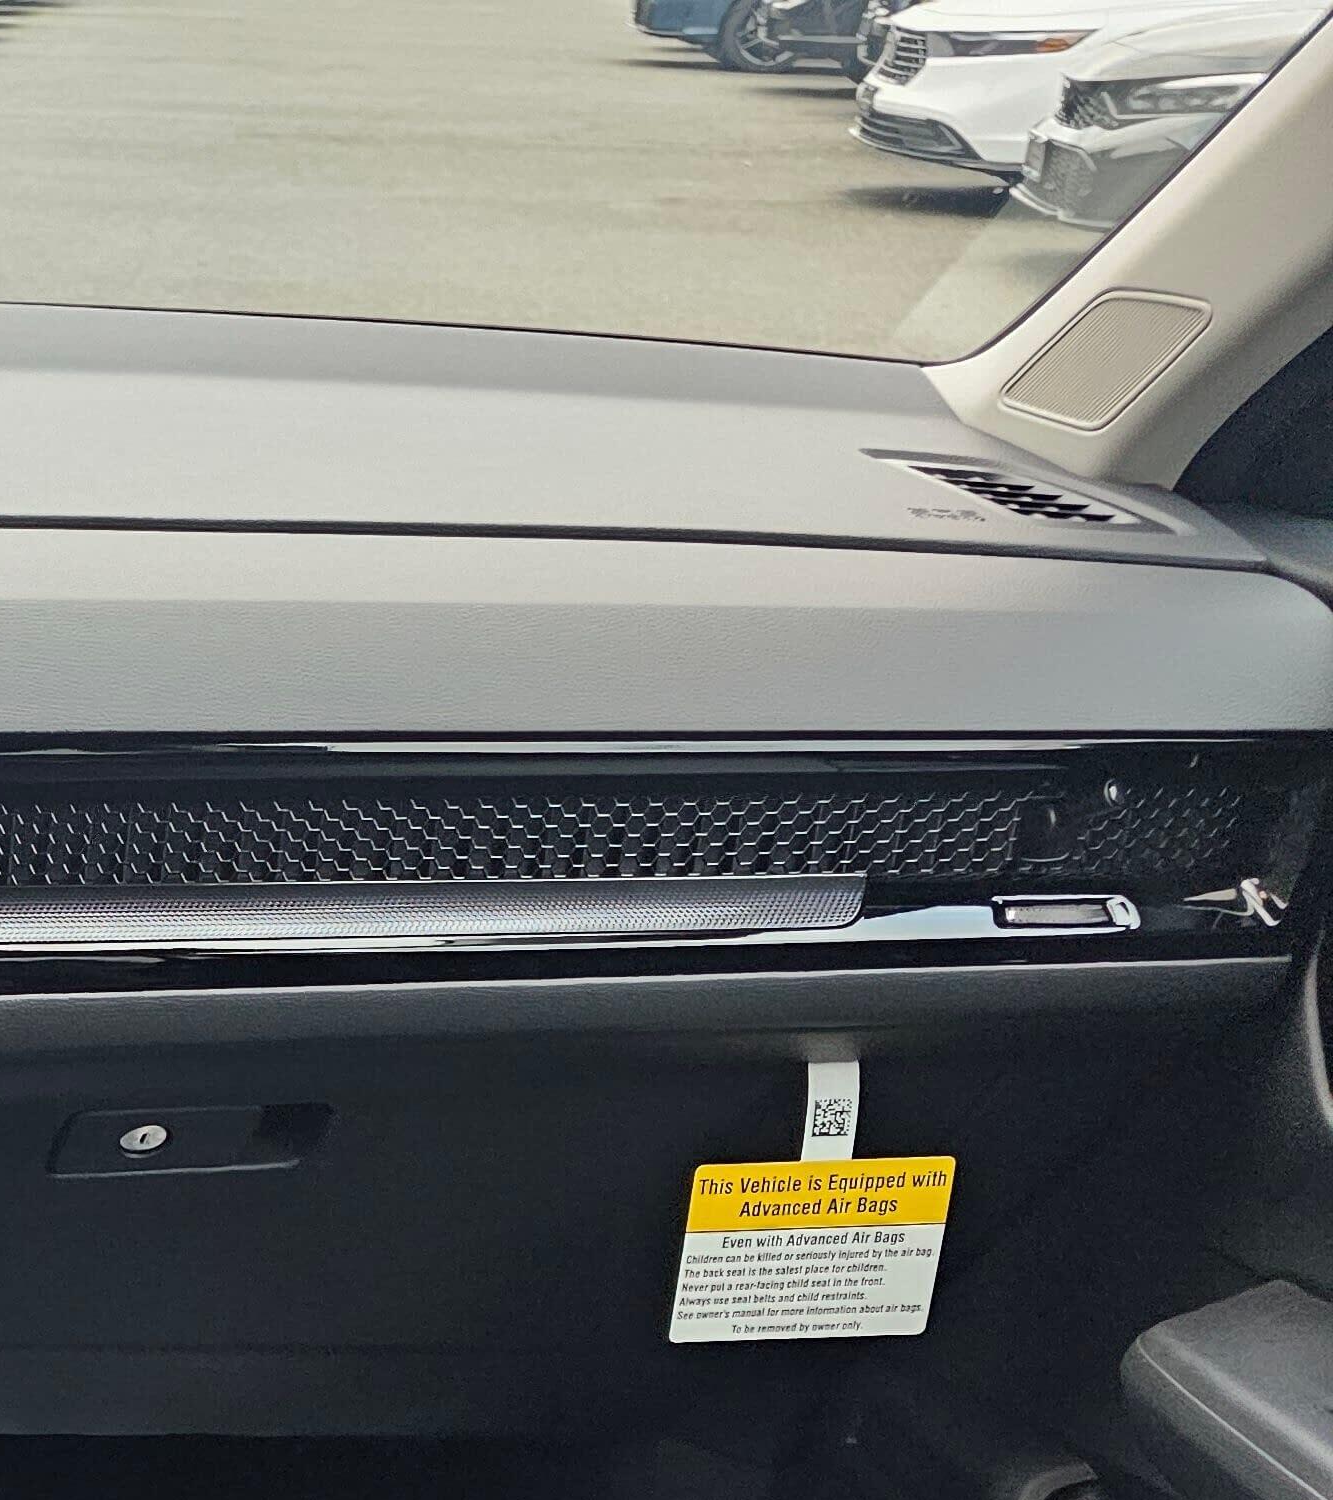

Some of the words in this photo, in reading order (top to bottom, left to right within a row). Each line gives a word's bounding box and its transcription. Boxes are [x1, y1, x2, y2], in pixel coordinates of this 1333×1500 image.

[699, 1178, 733, 1195] This
[740, 1176, 802, 1194] Vehicle
[807, 1176, 823, 1192] is
[828, 1172, 906, 1193] Equipped
[912, 1170, 948, 1188] with
[739, 1198, 822, 1218] Advanced
[826, 1198, 852, 1215] Air
[856, 1196, 899, 1216] Bags
[722, 1236, 753, 1249] Even
[756, 1234, 783, 1248] with
[786, 1233, 848, 1247] Advanced
[851, 1232, 872, 1244] Air
[874, 1231, 906, 1245] Bags
[686, 1254, 724, 1264] Children
[725, 1255, 742, 1263] can
[744, 1253, 755, 1262] be
[758, 1252, 782, 1262] killed
[795, 1250, 836, 1261] seriously
[838, 1249, 870, 1260] injured
[873, 1249, 882, 1259] by
[885, 1248, 899, 1257] the
[900, 1248, 914, 1257] air
[684, 1269, 701, 1278] The
[703, 1268, 725, 1278] back
[726, 1268, 746, 1277] seat
[748, 1267, 756, 1276] is
[759, 1266, 773, 1276] the
[804, 1264, 830, 1275] place
[831, 1263, 845, 1274] for
[681, 1283, 708, 1292] Never
[710, 1282, 725, 1293] put
[735, 1280, 785, 1292] rear-facing
[786, 1279, 809, 1289] child
[811, 1278, 831, 1288] seat
[833, 1277, 842, 1287] in
[844, 1277, 859, 1287] the
[679, 1296, 711, 1307] Always
[713, 1297, 729, 1305] use
[731, 1295, 751, 1304] seat
[753, 1294, 776, 1304] belts
[778, 1293, 795, 1303] and
[797, 1292, 819, 1302] child
[677, 1311, 694, 1320] See
[696, 1309, 730, 1319] owner's
[732, 1308, 765, 1318] manual
[766, 1307, 779, 1317] for
[781, 1308, 805, 1316] more
[806, 1305, 857, 1315] information
[859, 1304, 885, 1314] about
[885, 1303, 898, 1313] air
[732, 1324, 742, 1334] To
[744, 1324, 755, 1333] be
[757, 1322, 797, 1333] removed
[799, 1322, 809, 1333] by
[811, 1322, 839, 1331] owner
